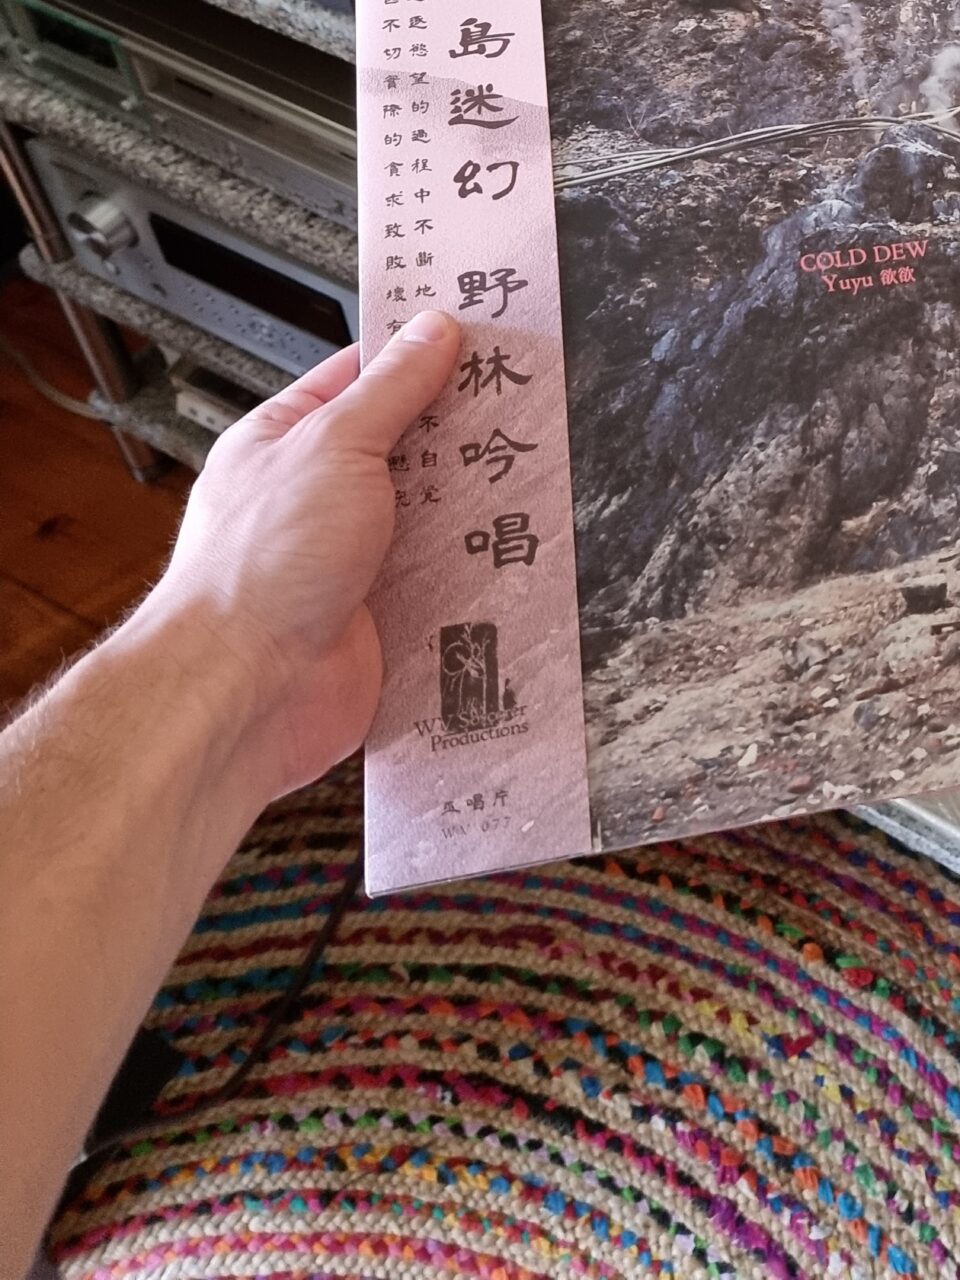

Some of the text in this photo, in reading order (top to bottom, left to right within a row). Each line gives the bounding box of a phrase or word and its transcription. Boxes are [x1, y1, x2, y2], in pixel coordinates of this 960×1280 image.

[800, 240, 929, 273] COLD DEW
[821, 273, 874, 296] Yuyu
[457, 268, 539, 569] 野林吟唱
[431, 721, 529, 752] Productions
